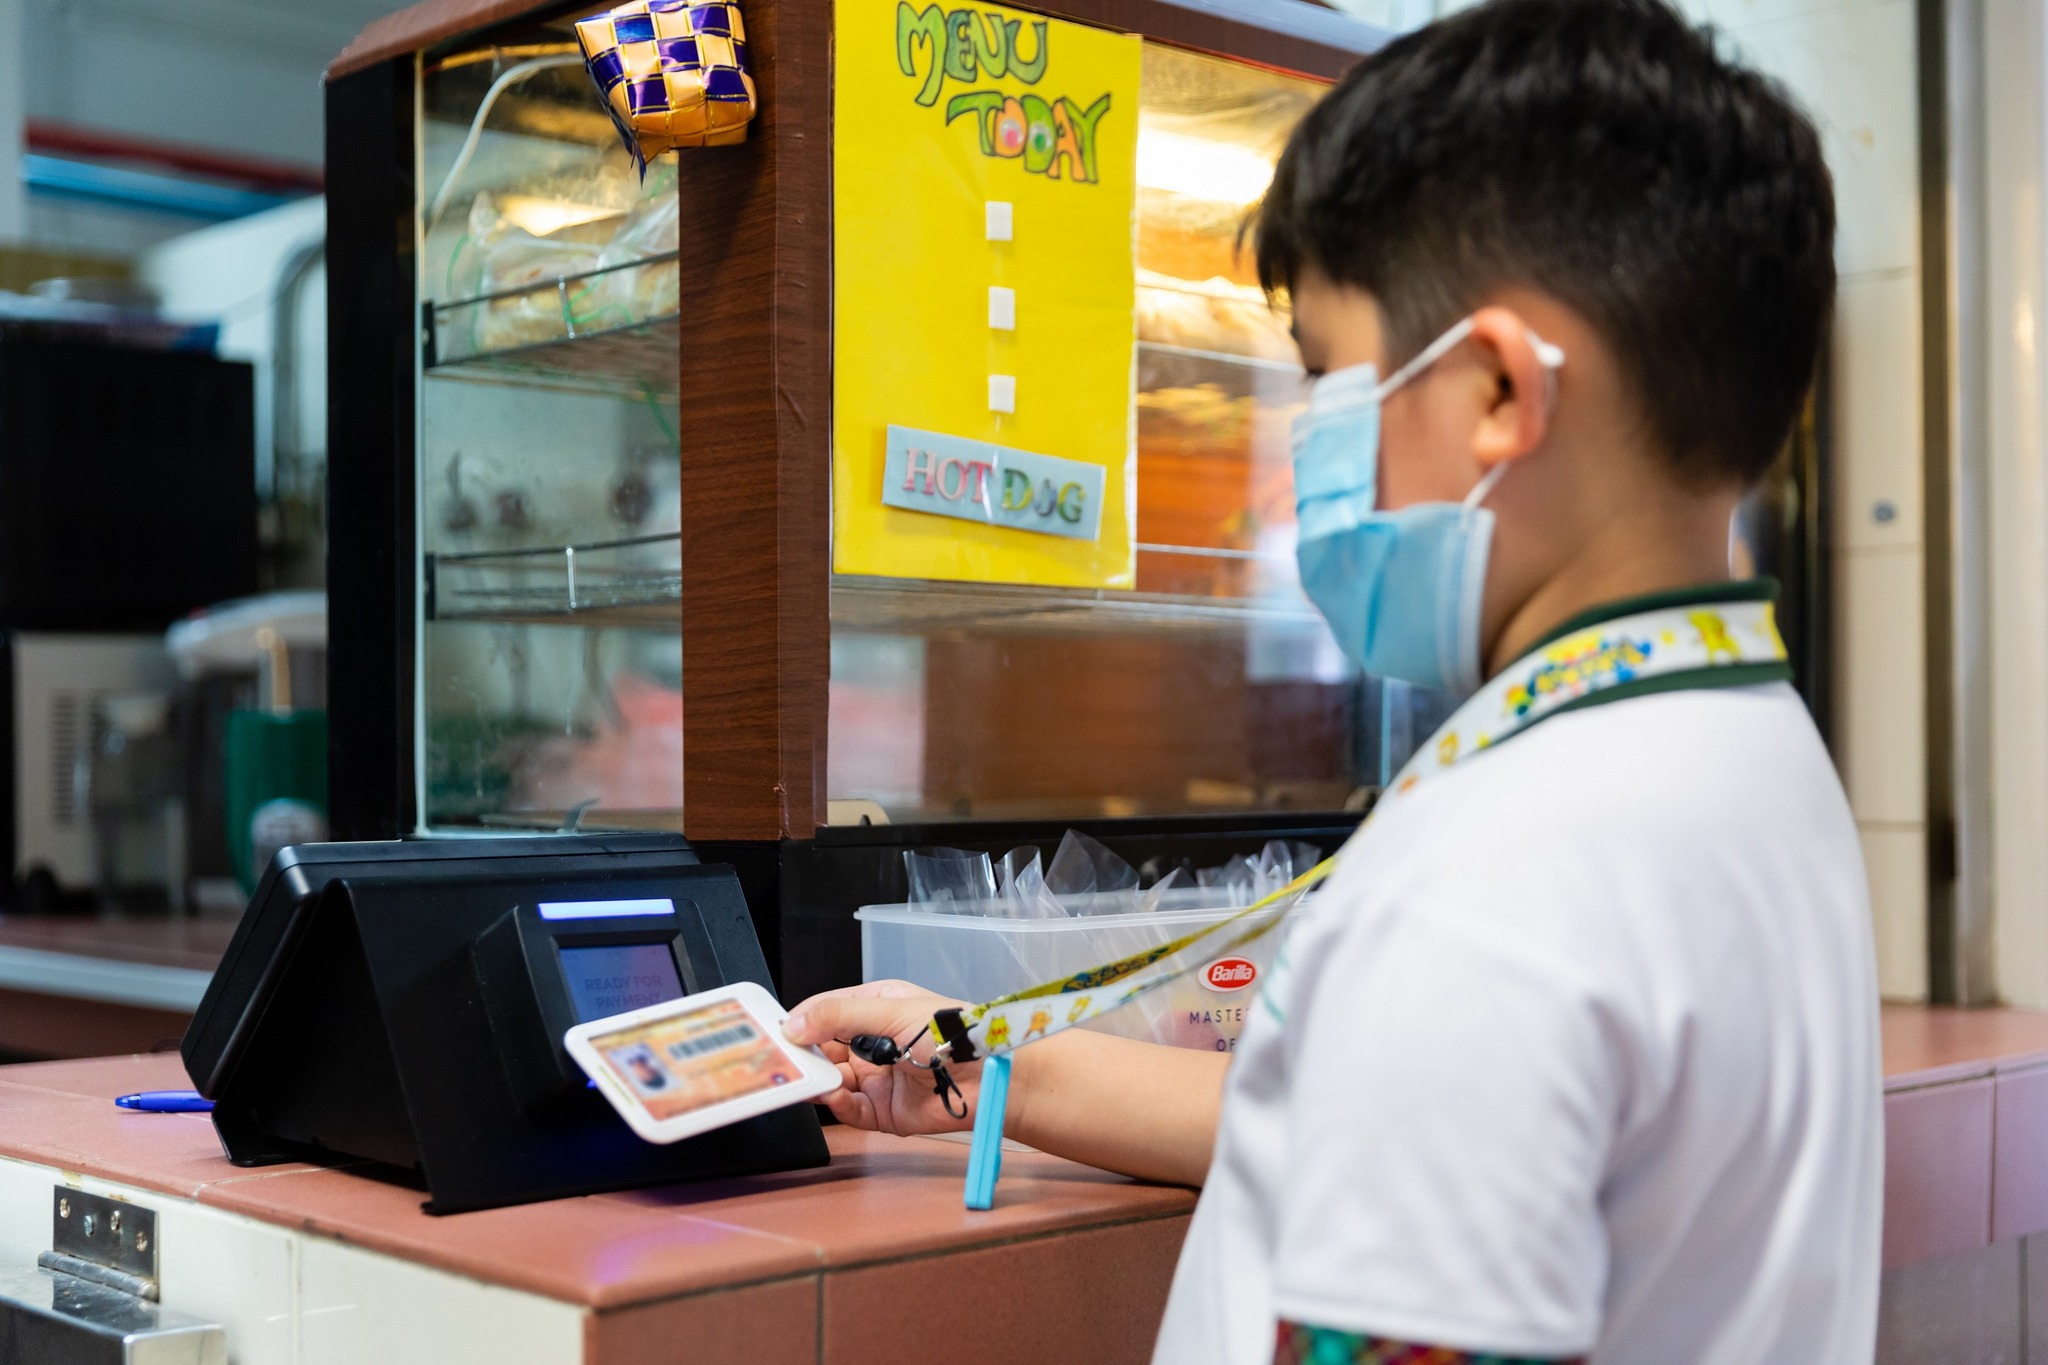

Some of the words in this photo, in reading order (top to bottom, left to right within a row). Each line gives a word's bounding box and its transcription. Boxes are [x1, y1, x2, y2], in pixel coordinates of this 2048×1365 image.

[896, 1, 1048, 107] MENU
[946, 90, 1111, 184] TODAY
[902, 448, 994, 502] HOT
[1001, 468, 1086, 523] DOG
[1211, 964, 1254, 982] Barilla
[584, 975, 630, 991] READY
[634, 974, 662, 988] FOR
[595, 992, 662, 1009] PAYMENT
[1216, 1038, 1236, 1052] OF
